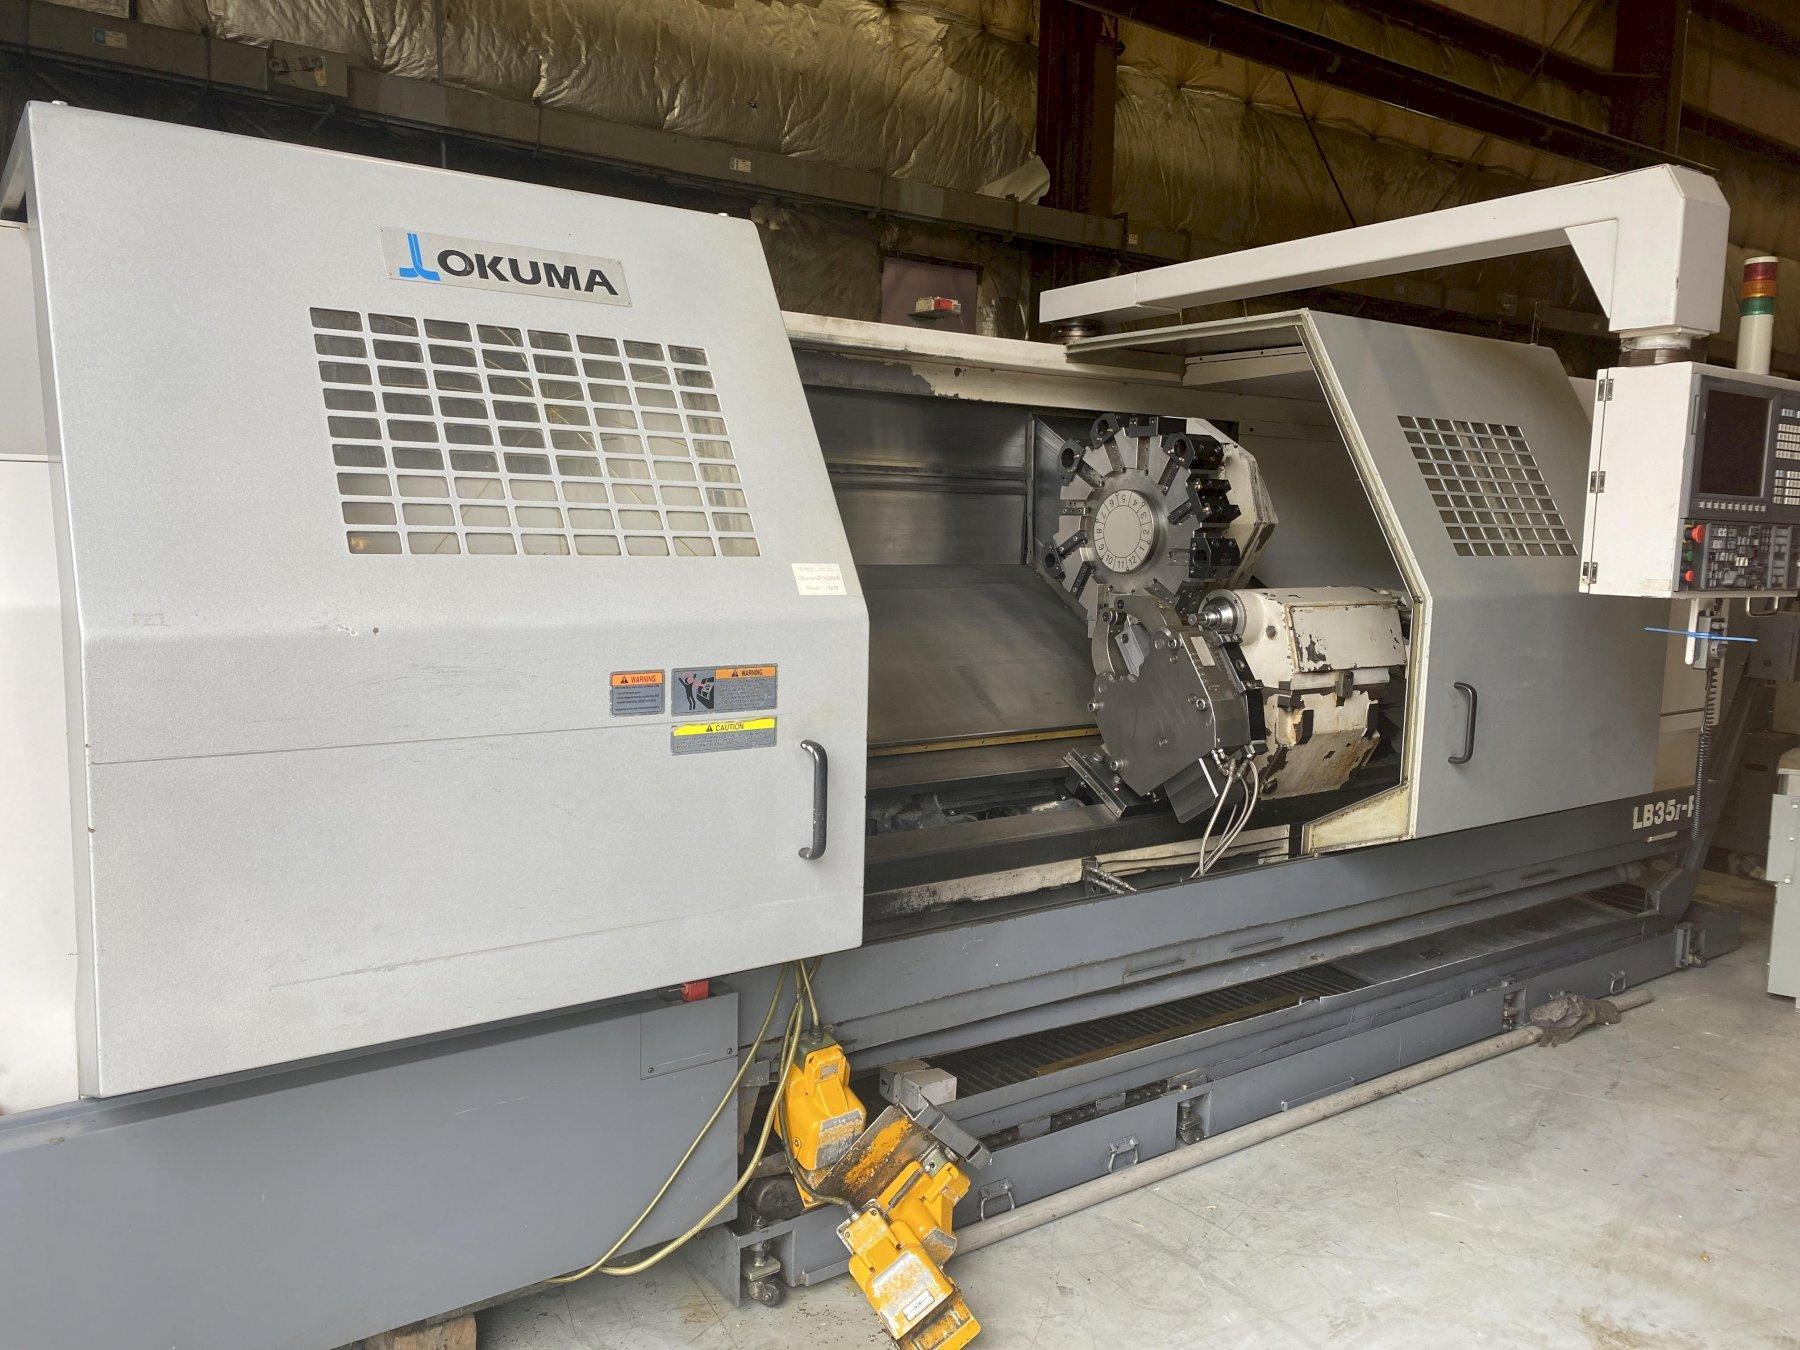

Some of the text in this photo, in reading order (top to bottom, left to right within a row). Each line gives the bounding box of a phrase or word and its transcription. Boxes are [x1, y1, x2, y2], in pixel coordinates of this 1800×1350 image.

[437, 249, 619, 296] OKUMA
[630, 675, 656, 684] WARNING
[715, 724, 744, 732] CAUTION
